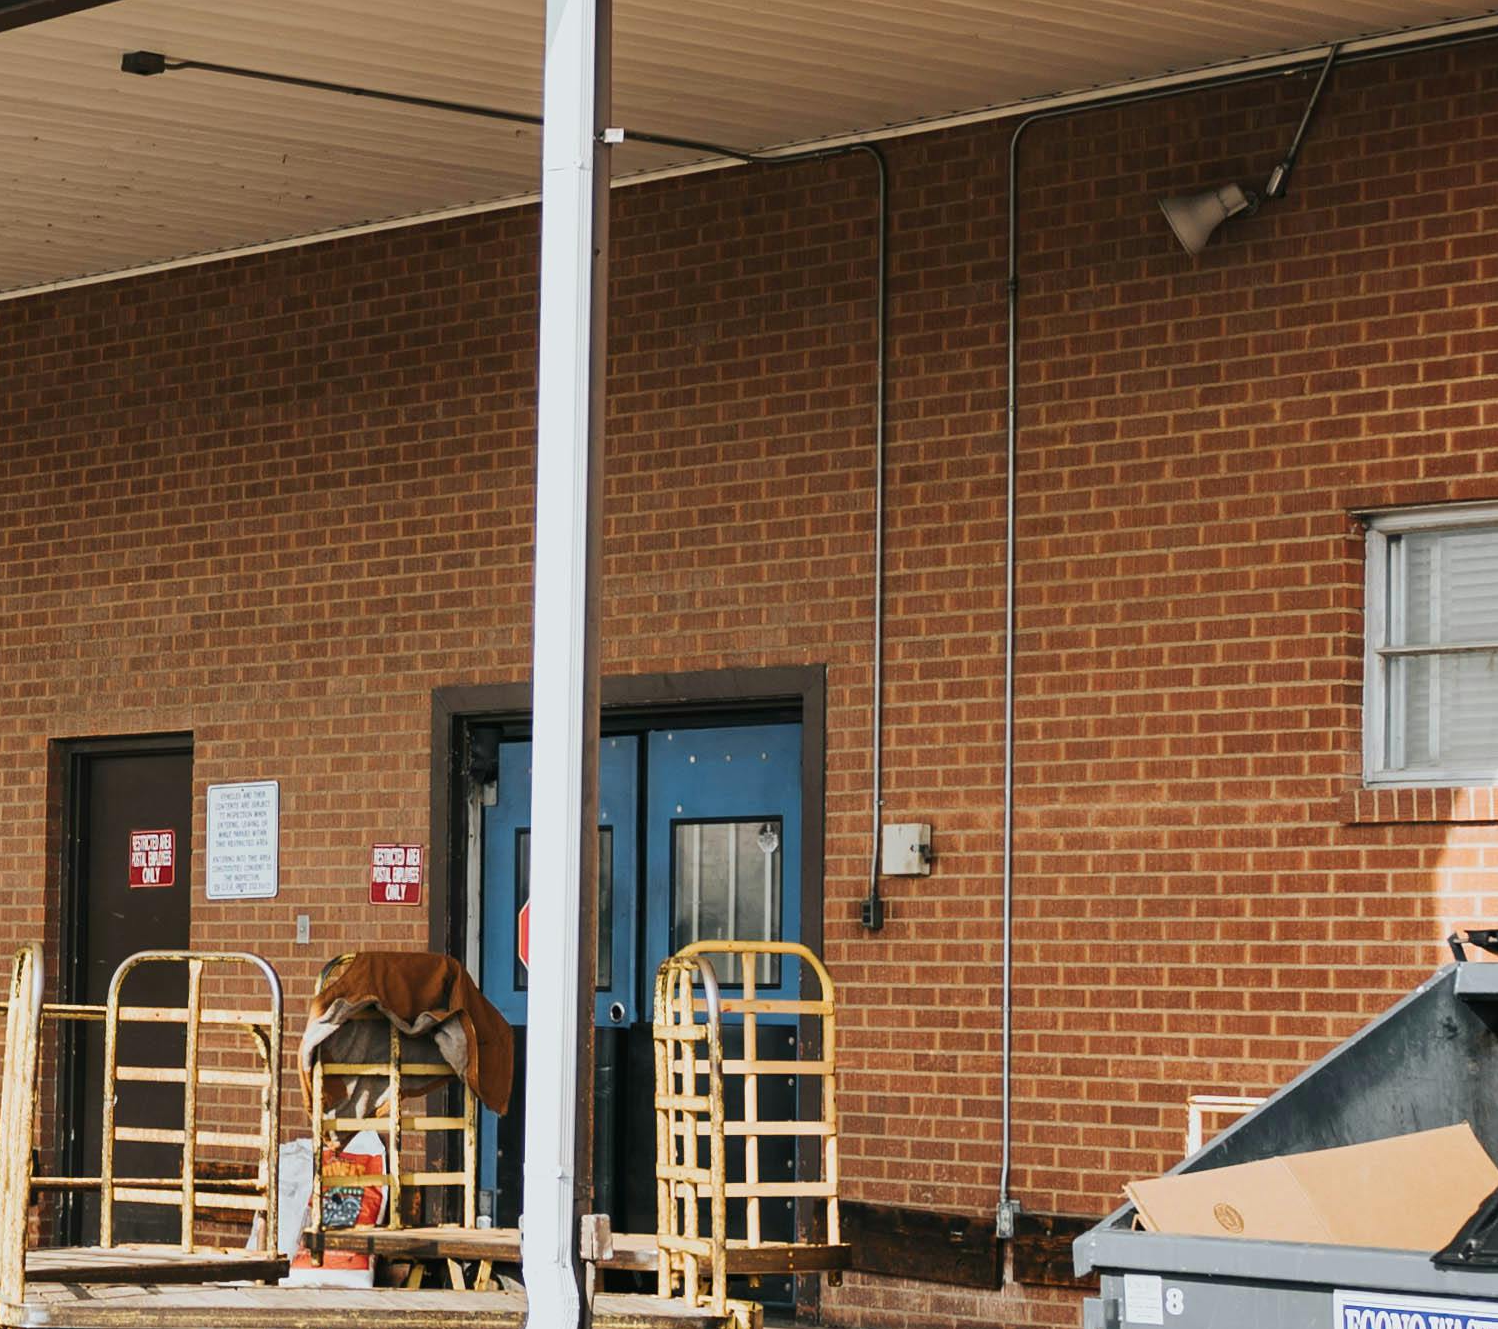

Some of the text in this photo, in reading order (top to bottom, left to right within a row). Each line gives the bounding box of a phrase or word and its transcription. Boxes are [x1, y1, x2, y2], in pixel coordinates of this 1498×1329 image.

[142, 867, 160, 884] ONLY
[385, 884, 407, 901] ONLY
[1166, 1287, 1184, 1315] 8
